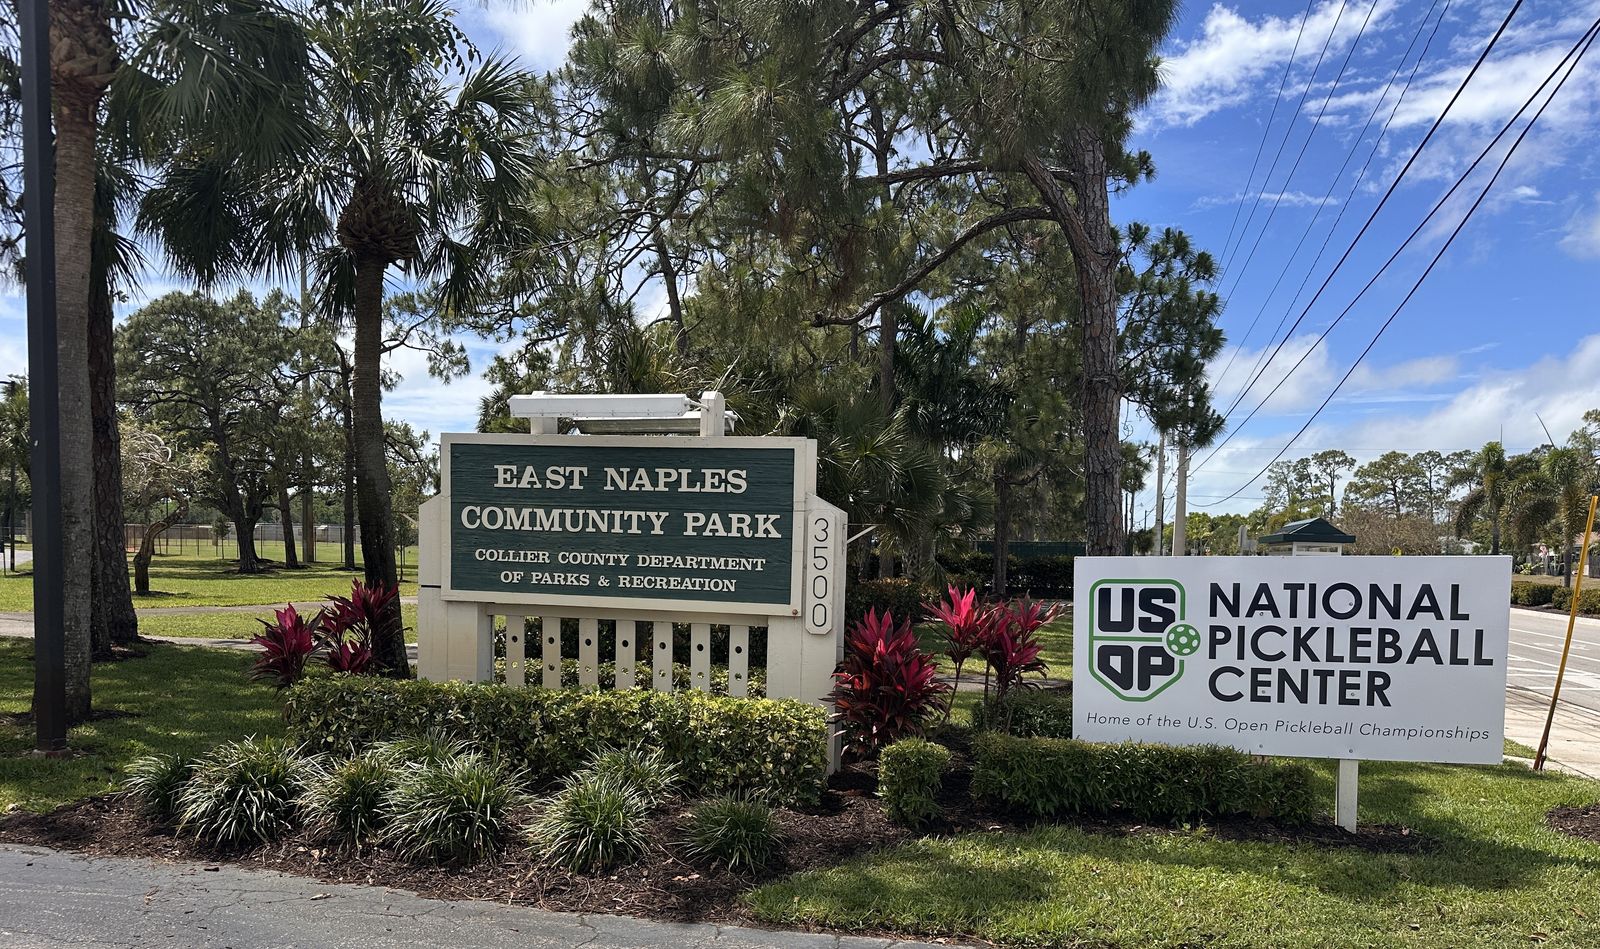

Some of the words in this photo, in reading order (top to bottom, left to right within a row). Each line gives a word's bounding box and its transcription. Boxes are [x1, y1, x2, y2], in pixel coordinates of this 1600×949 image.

[494, 464, 588, 490] EAST
[604, 467, 748, 494] NAPLES
[461, 505, 670, 535] COMMUNITY
[684, 512, 782, 539] PARK
[475, 548, 550, 564] COLLIER
[558, 551, 630, 567] COUNTY
[637, 554, 766, 571] DEPARTMENT
[812, 518, 829, 627] 3500
[500, 570, 524, 584] OF
[531, 571, 590, 586] PARKS
[598, 575, 610, 587] &
[618, 575, 737, 593] RECREATION
[1098, 587, 1176, 633] US
[1209, 582, 1470, 621] NATIONAL
[1208, 624, 1494, 666] PICKLEBALL
[1208, 666, 1392, 707] CENTER
[1087, 712, 1130, 727] Home
[1136, 713, 1154, 727] of
[1157, 714, 1181, 728] the
[1187, 716, 1217, 730] U.S.
[1224, 717, 1268, 734] Open
[1275, 719, 1353, 736] Pickleball
[1359, 722, 1490, 741] Championships
